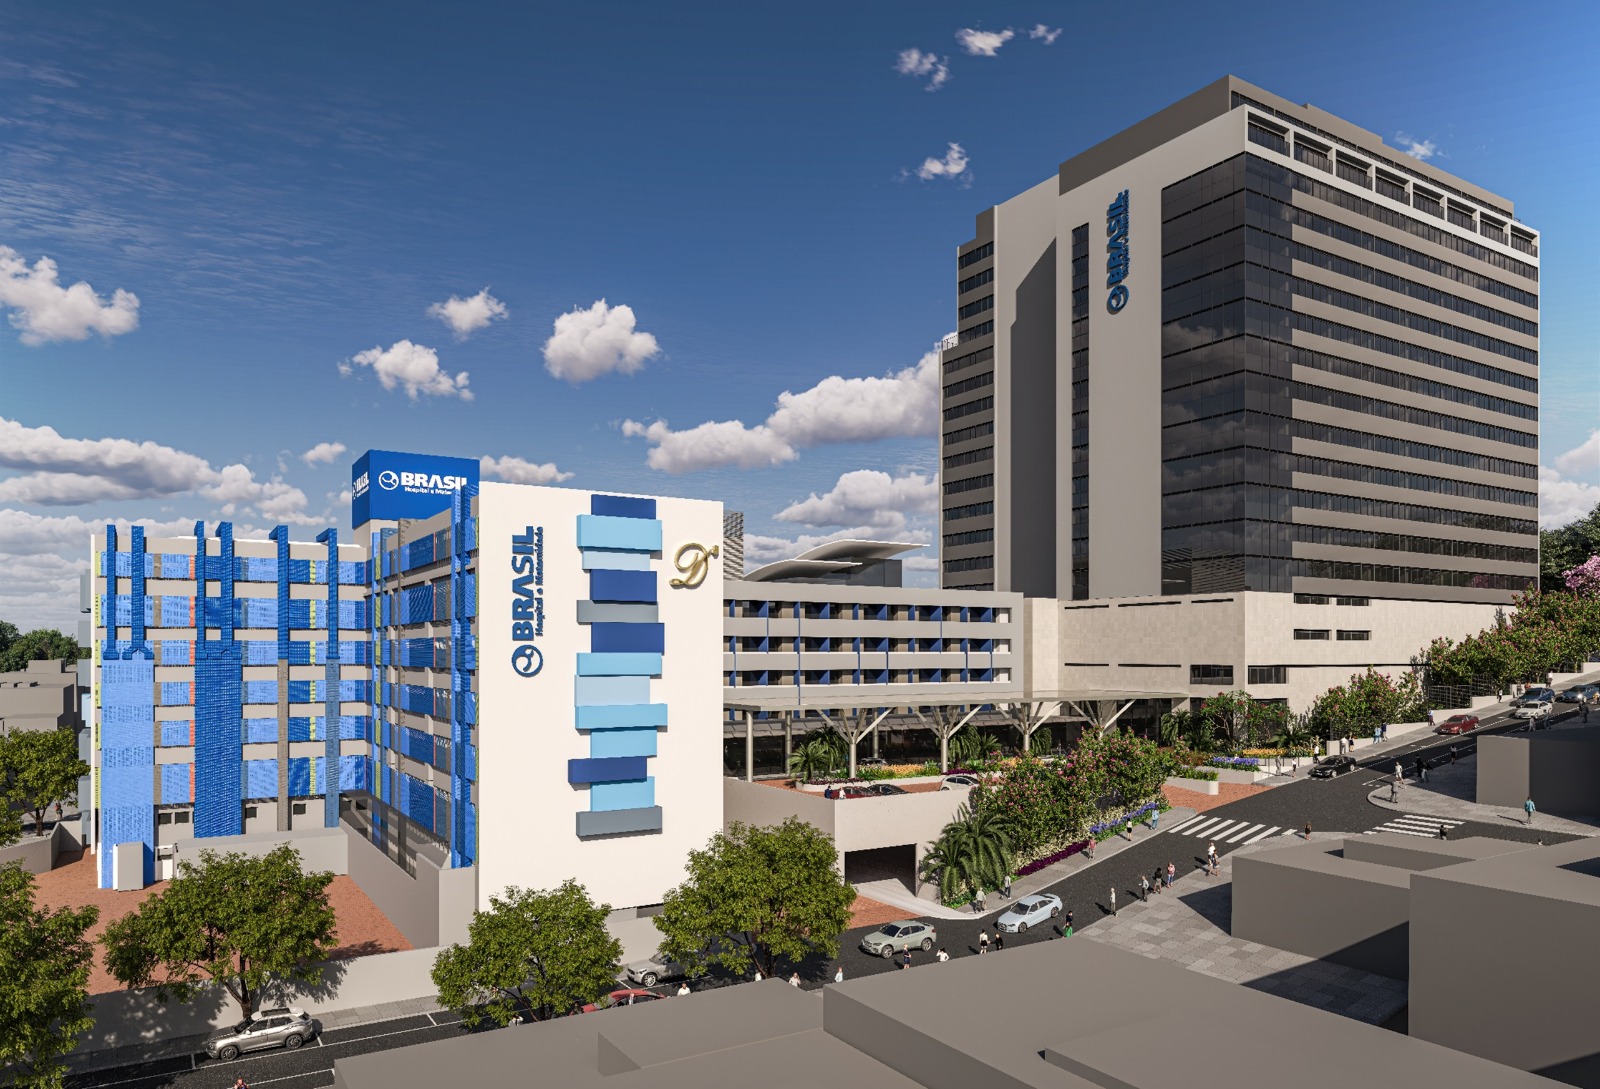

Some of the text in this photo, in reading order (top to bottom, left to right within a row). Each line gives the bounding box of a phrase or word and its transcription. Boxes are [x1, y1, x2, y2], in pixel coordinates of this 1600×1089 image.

[1107, 191, 1123, 287] BRASIL
[512, 526, 534, 641] BRASIL
[535, 526, 545, 637] Hospital e Maternidade
